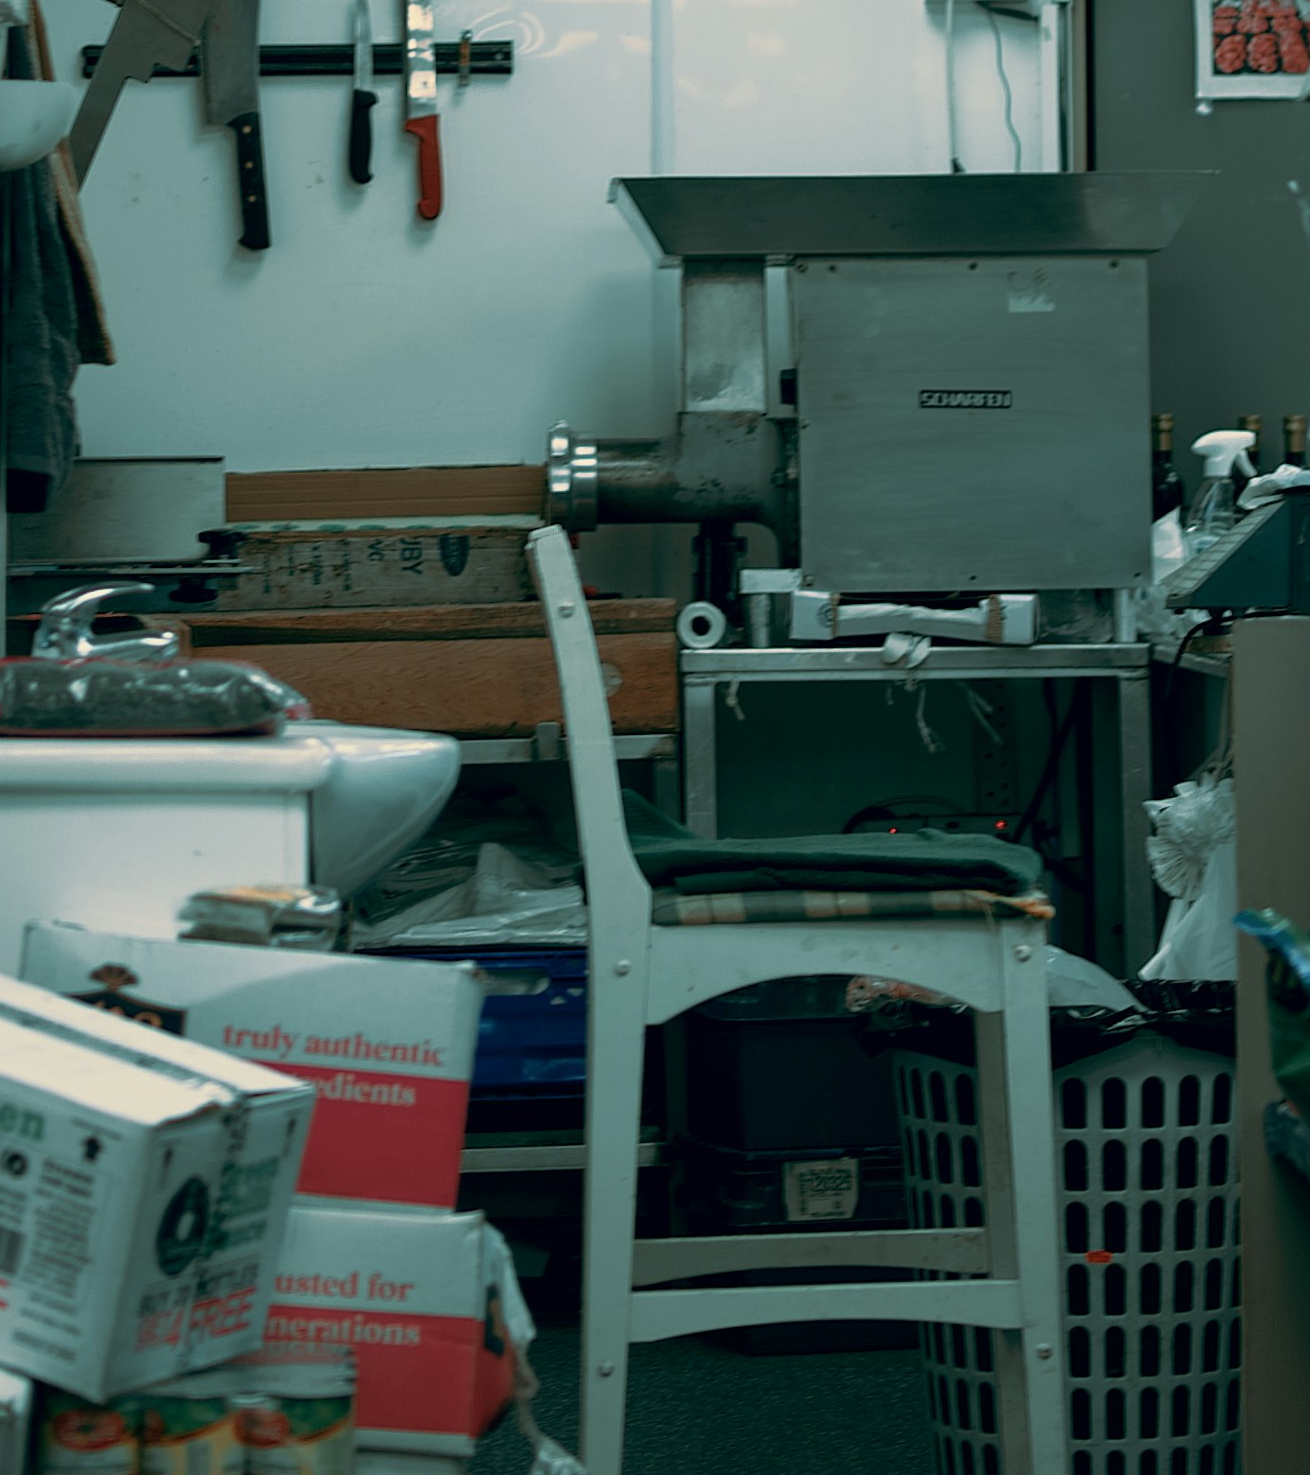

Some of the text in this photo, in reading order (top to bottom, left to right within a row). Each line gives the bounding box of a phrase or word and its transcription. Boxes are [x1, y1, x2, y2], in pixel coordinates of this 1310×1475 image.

[223, 1024, 447, 1067] truly authentic
[274, 1270, 415, 1302] usted for
[268, 1312, 422, 1347] nerations
